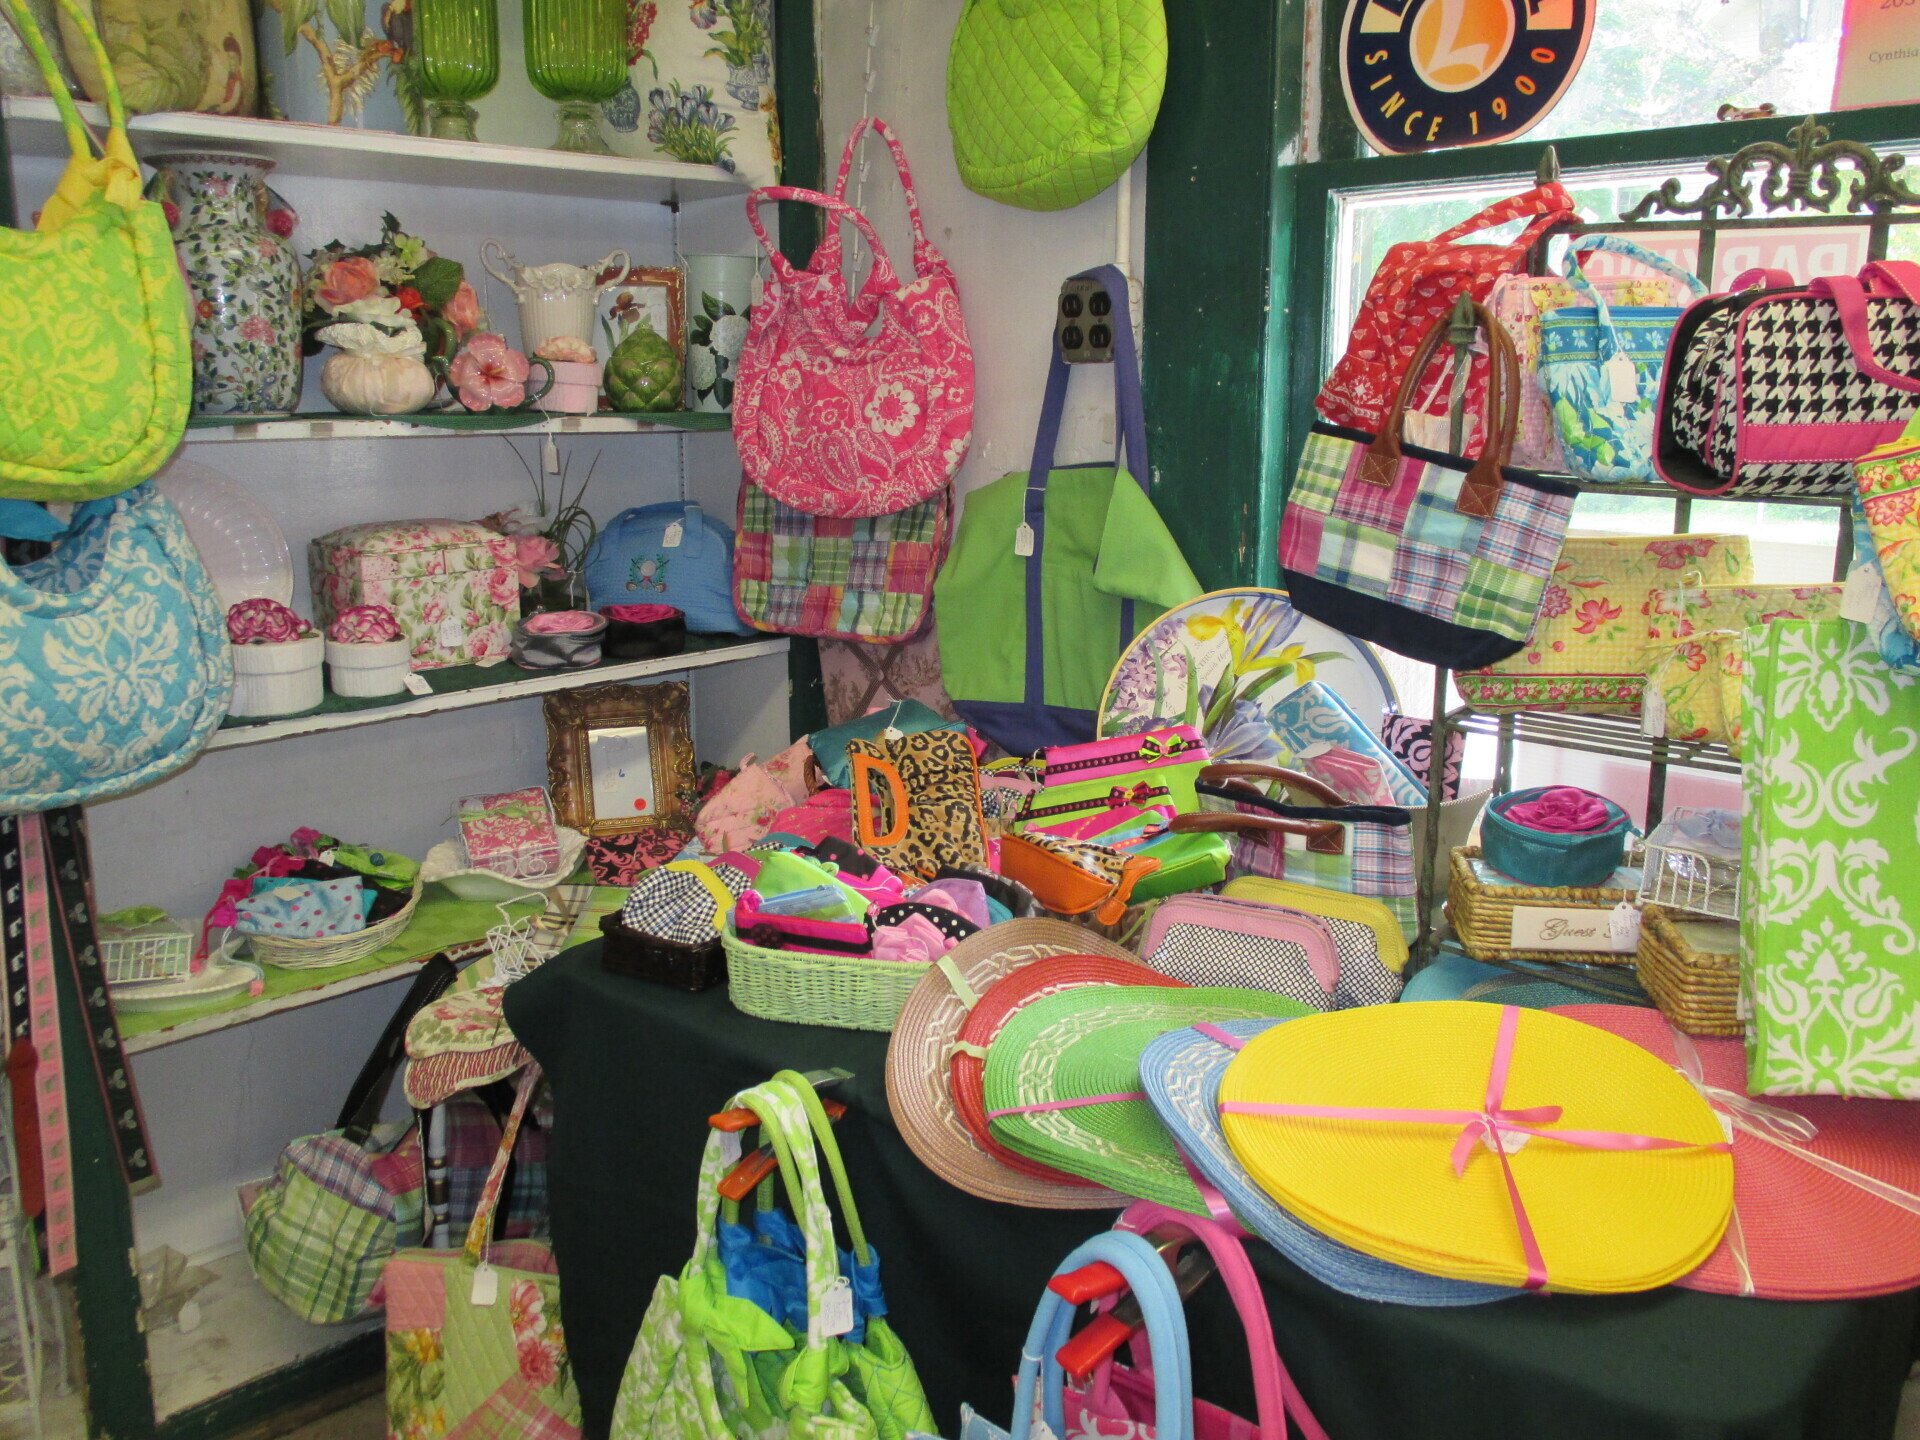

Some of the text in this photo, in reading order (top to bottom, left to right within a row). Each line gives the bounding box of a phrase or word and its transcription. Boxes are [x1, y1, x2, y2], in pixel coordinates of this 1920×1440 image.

[1364, 47, 1556, 141] SINCE 1900
[1539, 918, 1597, 941] Guest
